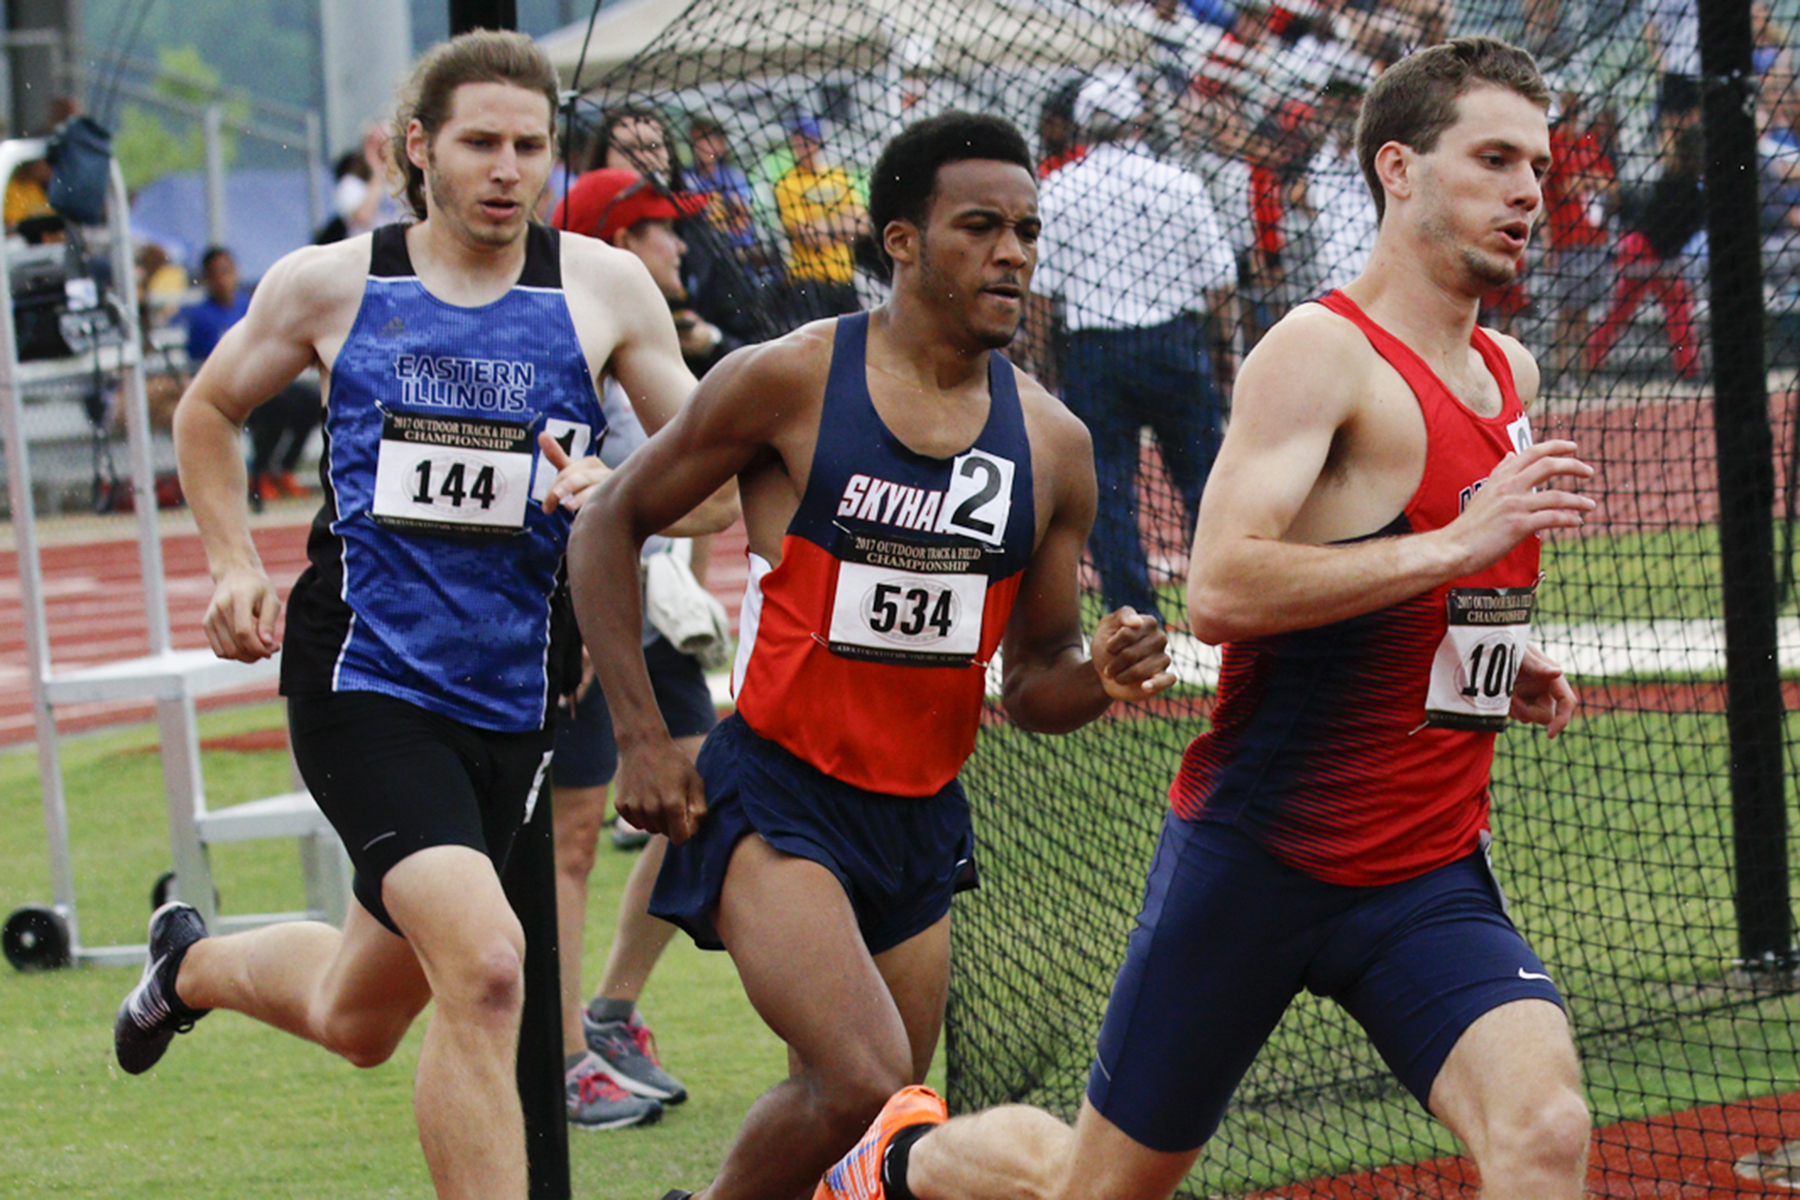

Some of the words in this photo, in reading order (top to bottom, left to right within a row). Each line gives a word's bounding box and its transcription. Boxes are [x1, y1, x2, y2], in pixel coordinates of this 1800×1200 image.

[394, 354, 534, 388] EASTERN
[402, 379, 526, 413] ILLINOIS
[404, 430, 513, 450] CHAMPIONSHIP
[413, 418, 459, 434] OUTDOOR
[461, 423, 491, 437] TRACK
[492, 426, 498, 437] &
[500, 427, 526, 440] FIELD
[412, 460, 496, 509] 144
[950, 456, 1002, 536] 2
[855, 537, 876, 551] 2017
[876, 540, 925, 559] OUTDOOR
[957, 547, 981, 560] FIELD
[866, 552, 970, 571] CHAMPIONSHIP
[870, 583, 952, 637] 534
